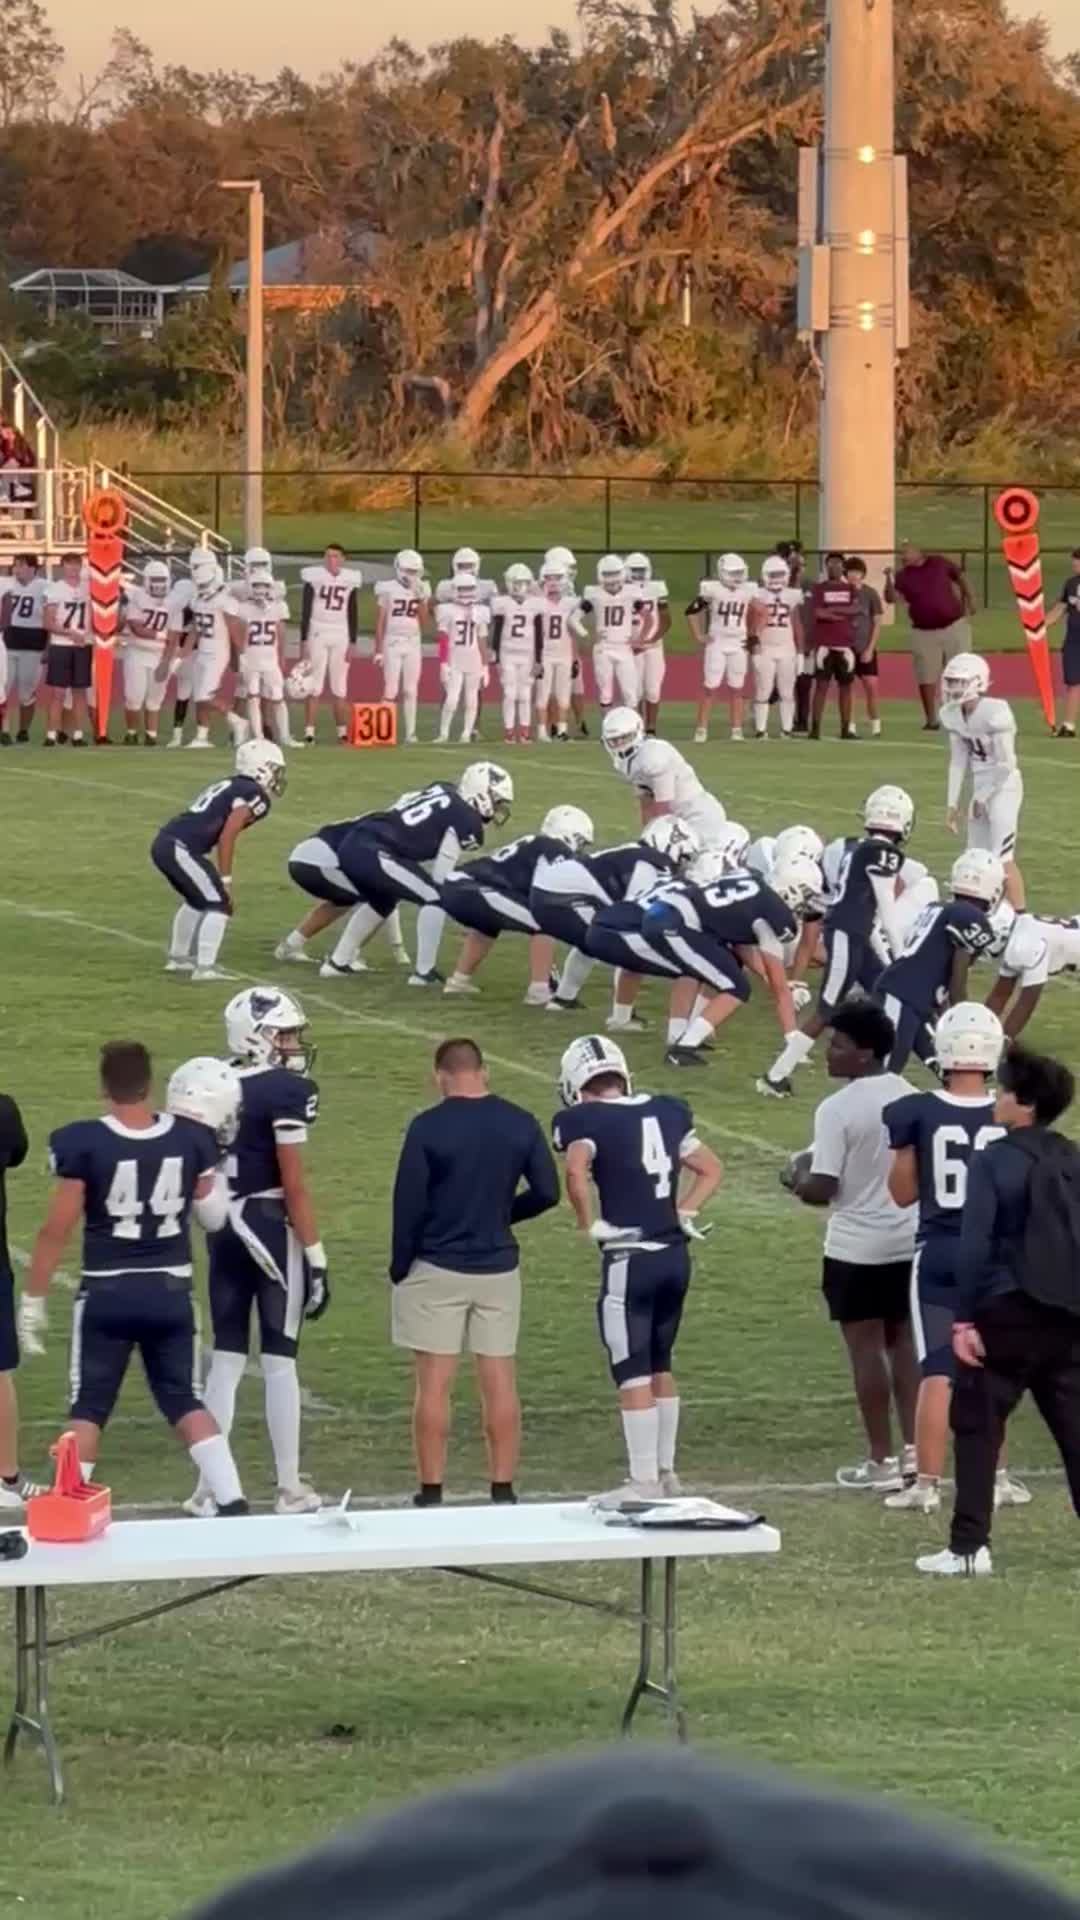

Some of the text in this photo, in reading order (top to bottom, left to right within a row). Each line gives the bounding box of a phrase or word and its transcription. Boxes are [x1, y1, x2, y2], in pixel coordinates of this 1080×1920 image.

[11, 595, 34, 618] 78
[319, 585, 346, 611] 45
[391, 600, 419, 618] 26
[63, 601, 86, 630] 71
[142, 608, 168, 632] 70
[604, 606, 625, 627] 10
[718, 601, 745, 627] 44
[249, 621, 276, 646] 25
[454, 620, 475, 646] 31
[511, 615, 526, 638] 2
[550, 615, 562, 639] 8
[358, 707, 393, 741] 30
[878, 850, 899, 870] 13
[963, 922, 989, 944] 39
[641, 1115, 673, 1199] 4
[105, 1156, 185, 1240] 44
